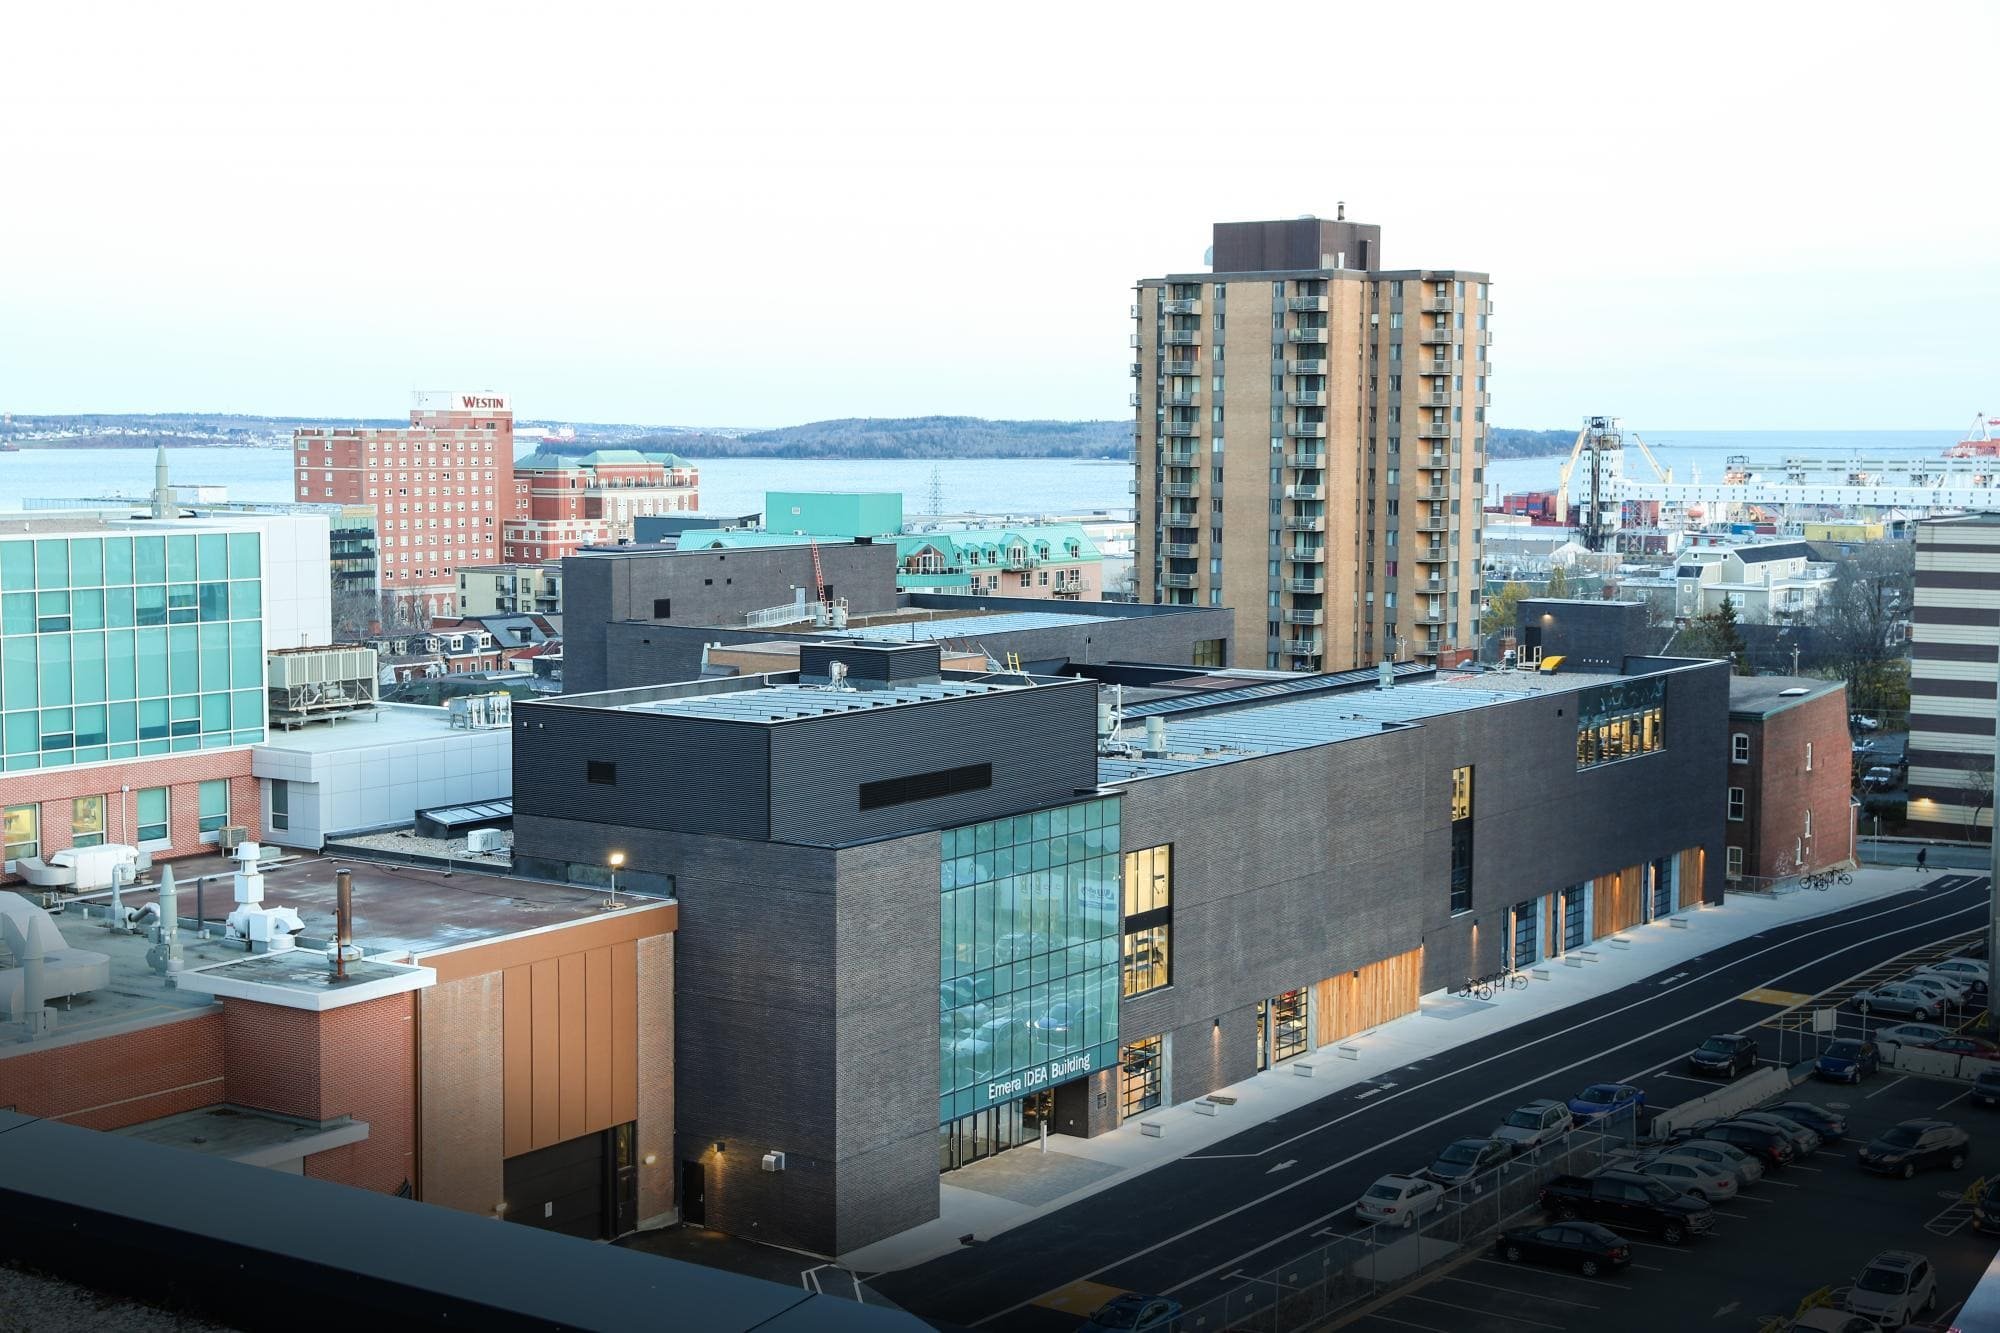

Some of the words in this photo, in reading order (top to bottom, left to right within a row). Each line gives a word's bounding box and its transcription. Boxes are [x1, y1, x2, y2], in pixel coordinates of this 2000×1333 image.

[462, 396, 504, 408] WESTIN
[988, 1079, 1021, 1100] Emera
[1024, 1067, 1048, 1088] IDEA
[1051, 1053, 1091, 1078] Building
